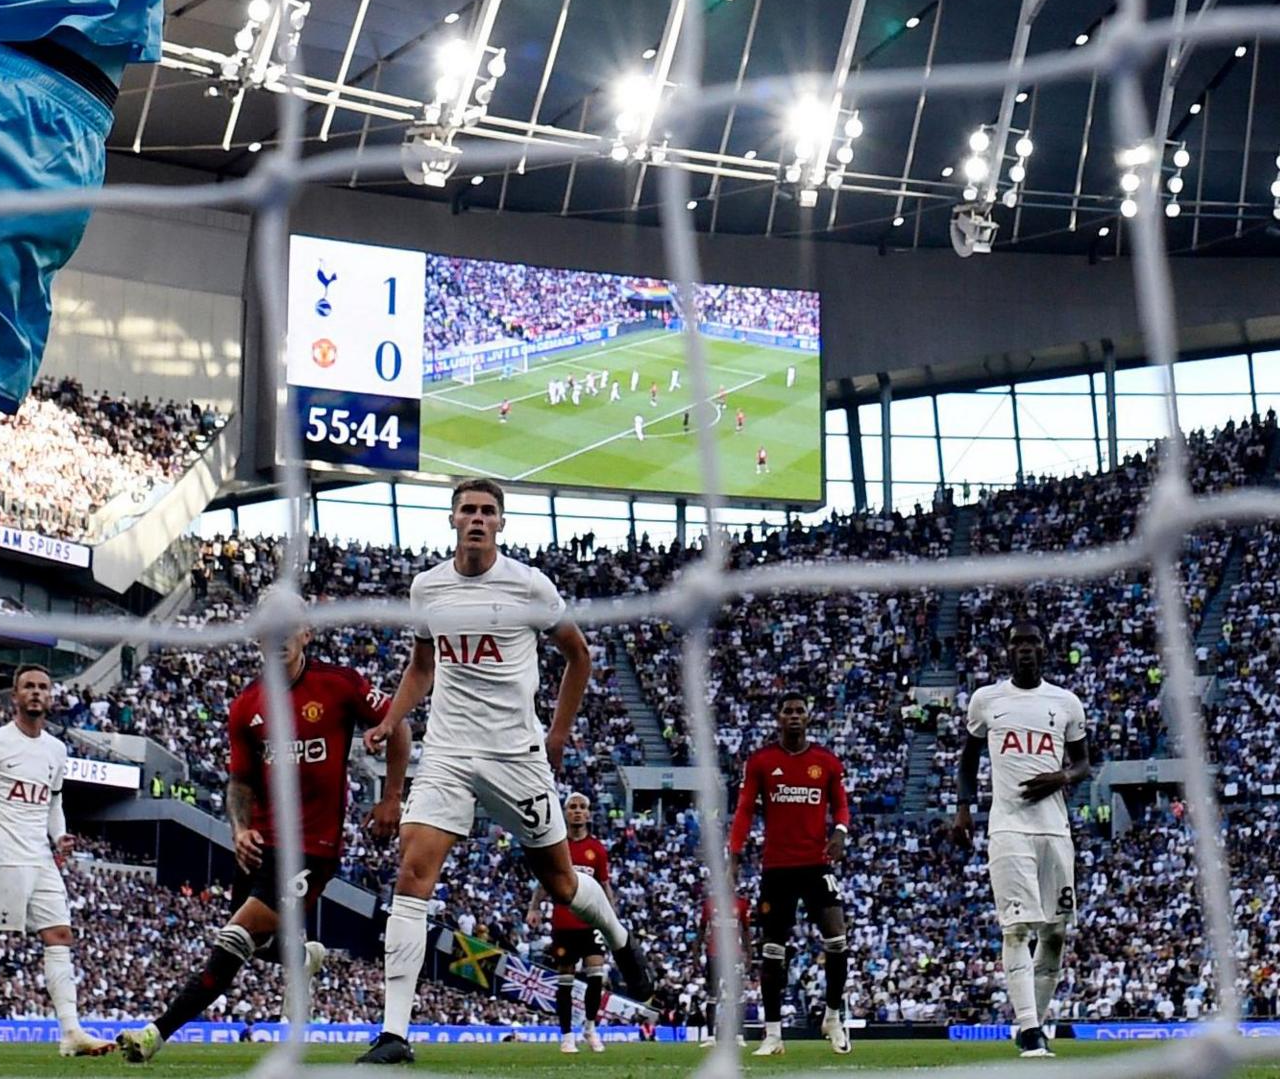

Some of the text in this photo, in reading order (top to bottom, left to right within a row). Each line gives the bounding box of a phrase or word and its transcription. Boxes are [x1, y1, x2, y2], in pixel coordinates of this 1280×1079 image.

[383, 276, 397, 316] 1
[375, 340, 402, 382] 0
[306, 406, 402, 450] 55:44
[28, 536, 71, 561] SPURS
[437, 634, 504, 665] AIA
[1000, 731, 1056, 755] AIA
[6, 780, 49, 805] AIA
[770, 792, 809, 804] Viewer
[777, 784, 809, 796] Team
[517, 792, 552, 830] 37
[287, 869, 312, 897] 6
[1058, 886, 1074, 910] 8
